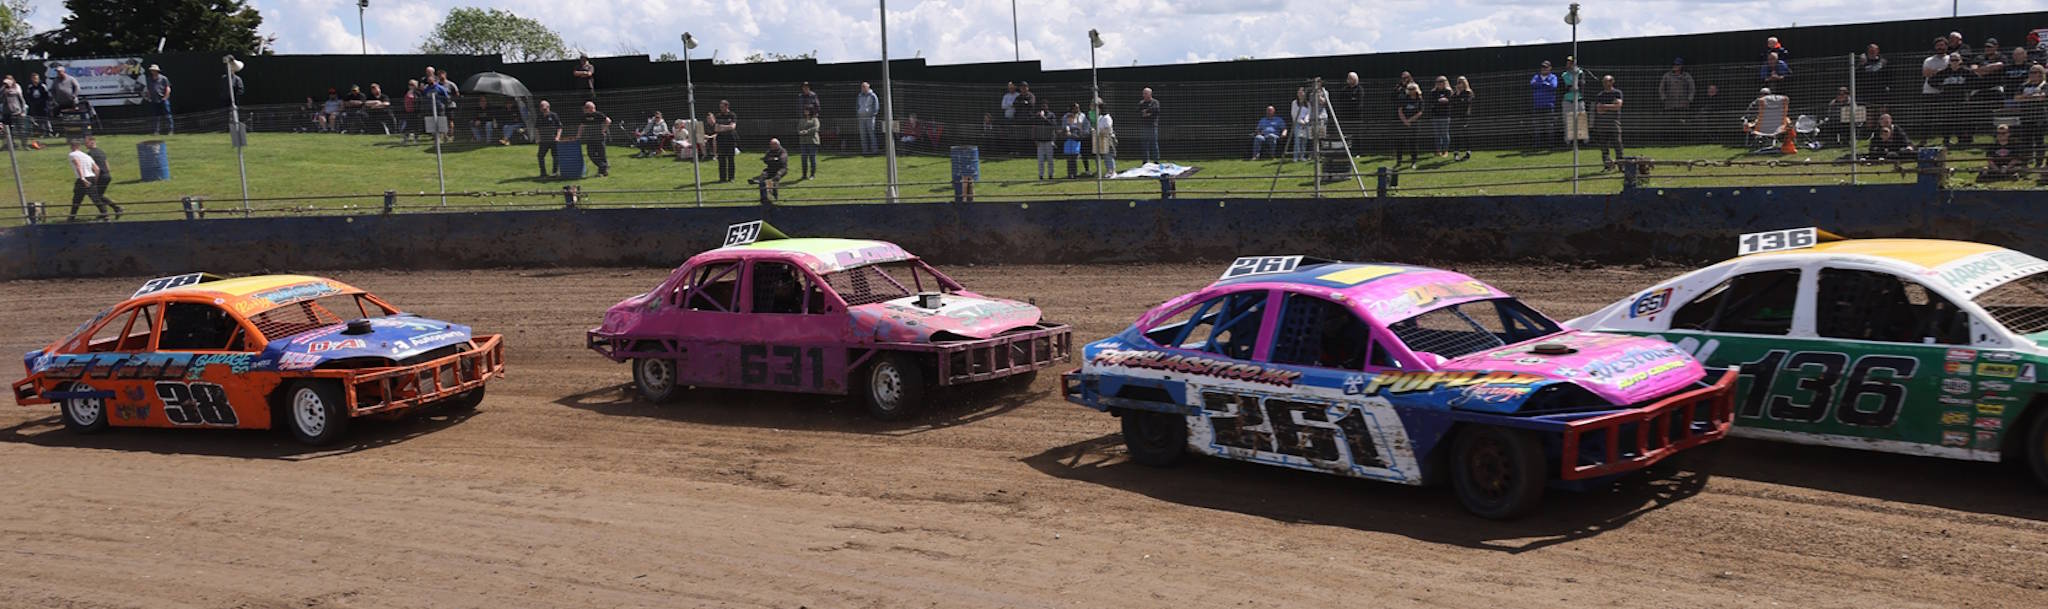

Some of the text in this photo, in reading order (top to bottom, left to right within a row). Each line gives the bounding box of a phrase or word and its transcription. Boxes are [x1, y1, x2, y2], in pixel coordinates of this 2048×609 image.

[726, 223, 760, 245] 631
[1743, 229, 1813, 252] 136
[1228, 257, 1297, 277] 261
[741, 344, 824, 391] 631
[1739, 349, 1920, 427] 136
[154, 380, 239, 426] 38
[1201, 390, 1389, 468] 261
